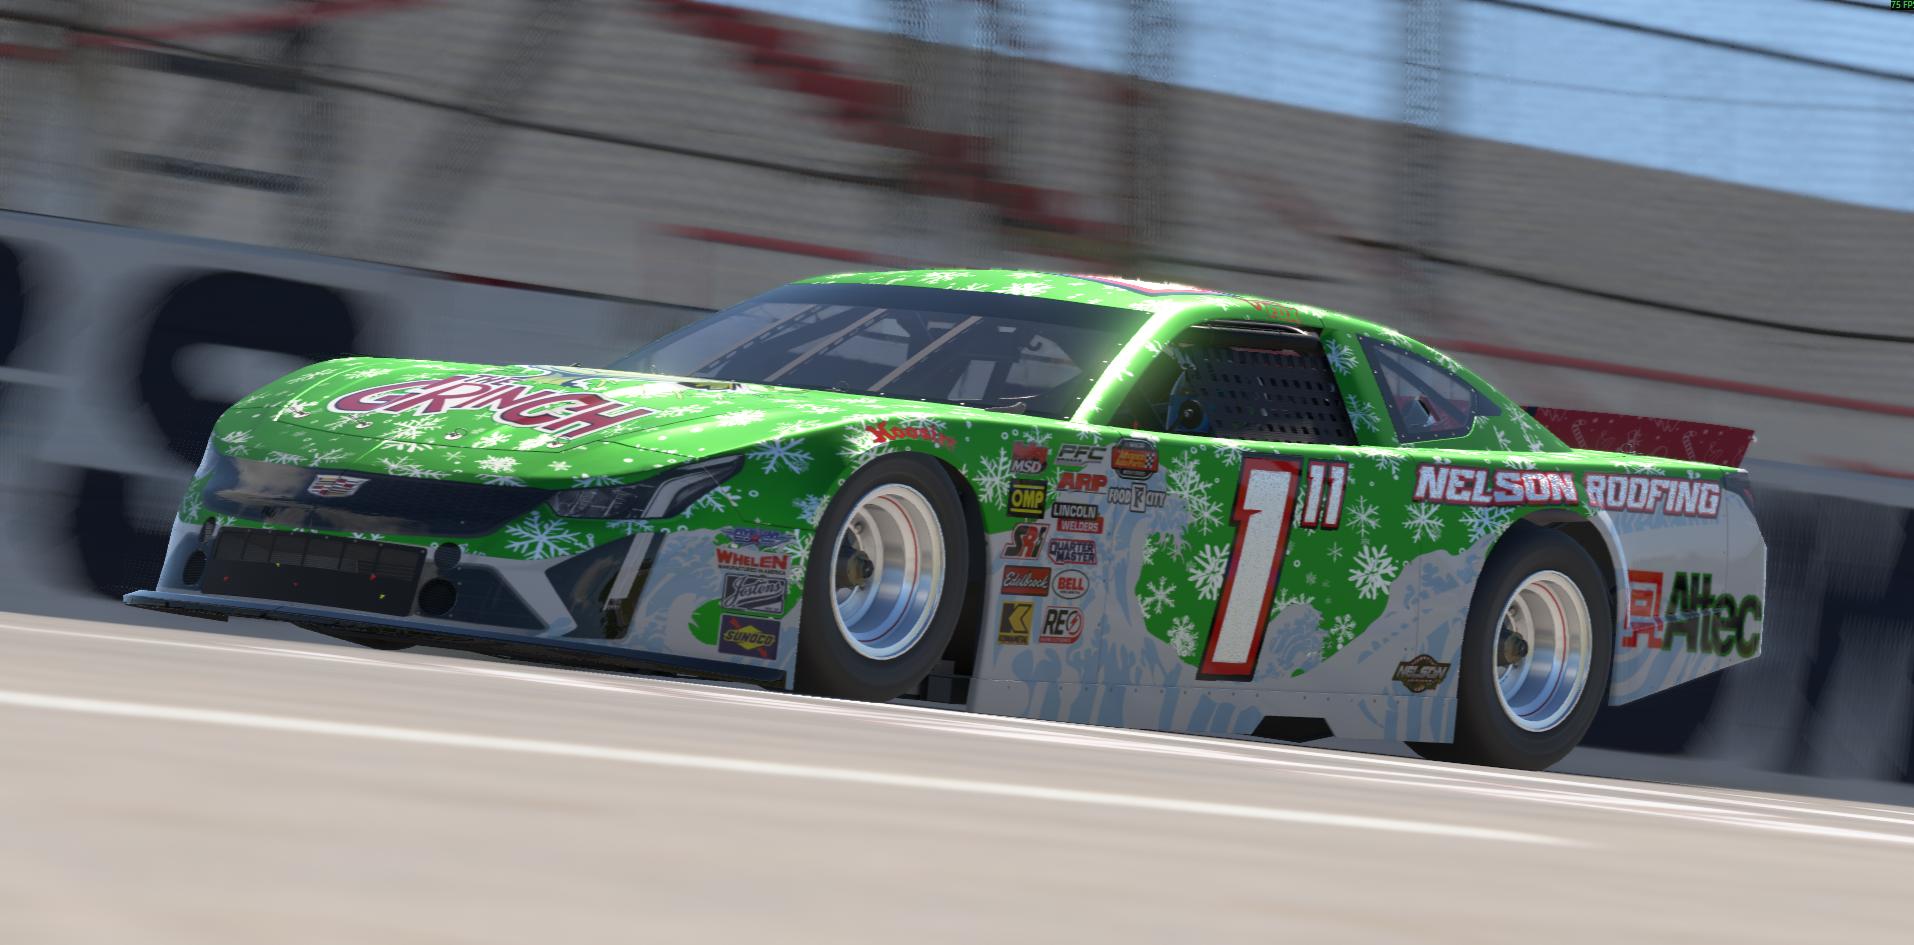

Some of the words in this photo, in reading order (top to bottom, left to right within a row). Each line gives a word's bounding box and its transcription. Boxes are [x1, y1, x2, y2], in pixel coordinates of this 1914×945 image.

[330, 374, 653, 439] GRINCH
[1058, 445, 1106, 460] PFC
[1011, 459, 1042, 473] MSD
[1057, 472, 1108, 492] ARP
[1412, 463, 1579, 506] NELSON
[1583, 473, 1722, 518] ROOFING
[1012, 489, 1045, 508] OMP
[1108, 487, 1132, 505] FOOD
[1146, 490, 1166, 508] CITY
[1301, 460, 1348, 529] 11
[1052, 503, 1097, 518] LINCOLN
[1061, 518, 1098, 532] WELDERS
[1049, 540, 1094, 554] QUARTER
[1056, 551, 1095, 562] MASTER
[716, 548, 789, 570] WHELEN
[1200, 456, 1302, 678] 1
[725, 574, 783, 608] Jostens
[1057, 576, 1084, 591] BELL
[1661, 571, 1762, 658] Altec
[724, 629, 776, 646] SUNOCO
[1397, 664, 1449, 679] NELSON
